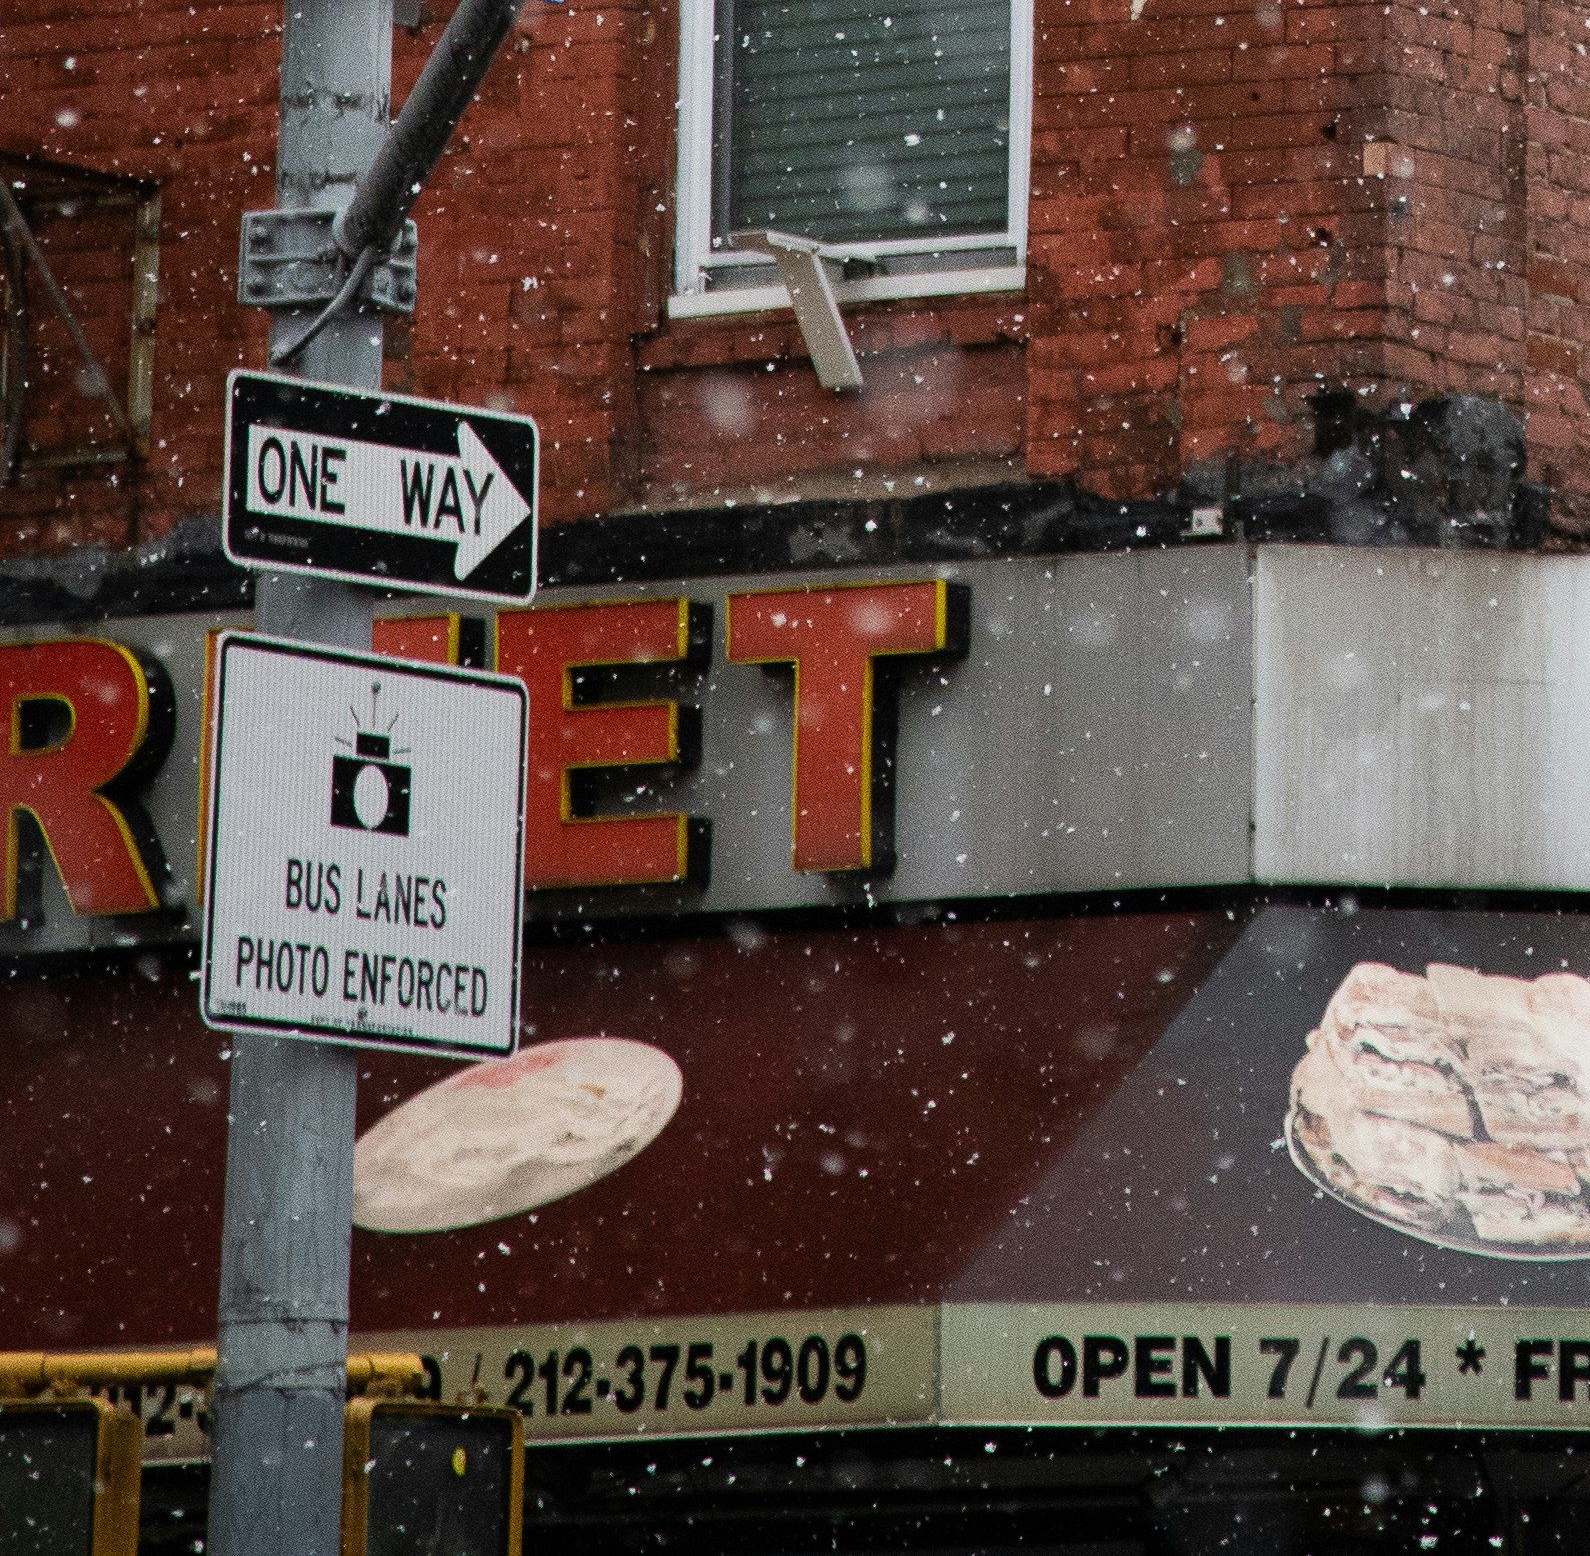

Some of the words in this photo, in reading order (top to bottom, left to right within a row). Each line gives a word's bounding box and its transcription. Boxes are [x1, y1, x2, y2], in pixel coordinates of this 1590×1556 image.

[257, 436, 347, 516] ONE
[400, 457, 495, 537] WAY
[0, 579, 950, 919] RET
[285, 856, 341, 916] BUS
[355, 868, 447, 930] LANES
[235, 934, 329, 998] PHOTO
[343, 948, 488, 1019] ENFORCED
[503, 1332, 869, 1419] 212-375-1909
[1032, 1334, 1232, 1401] OPEN
[1258, 1334, 1427, 1409] 7/24
